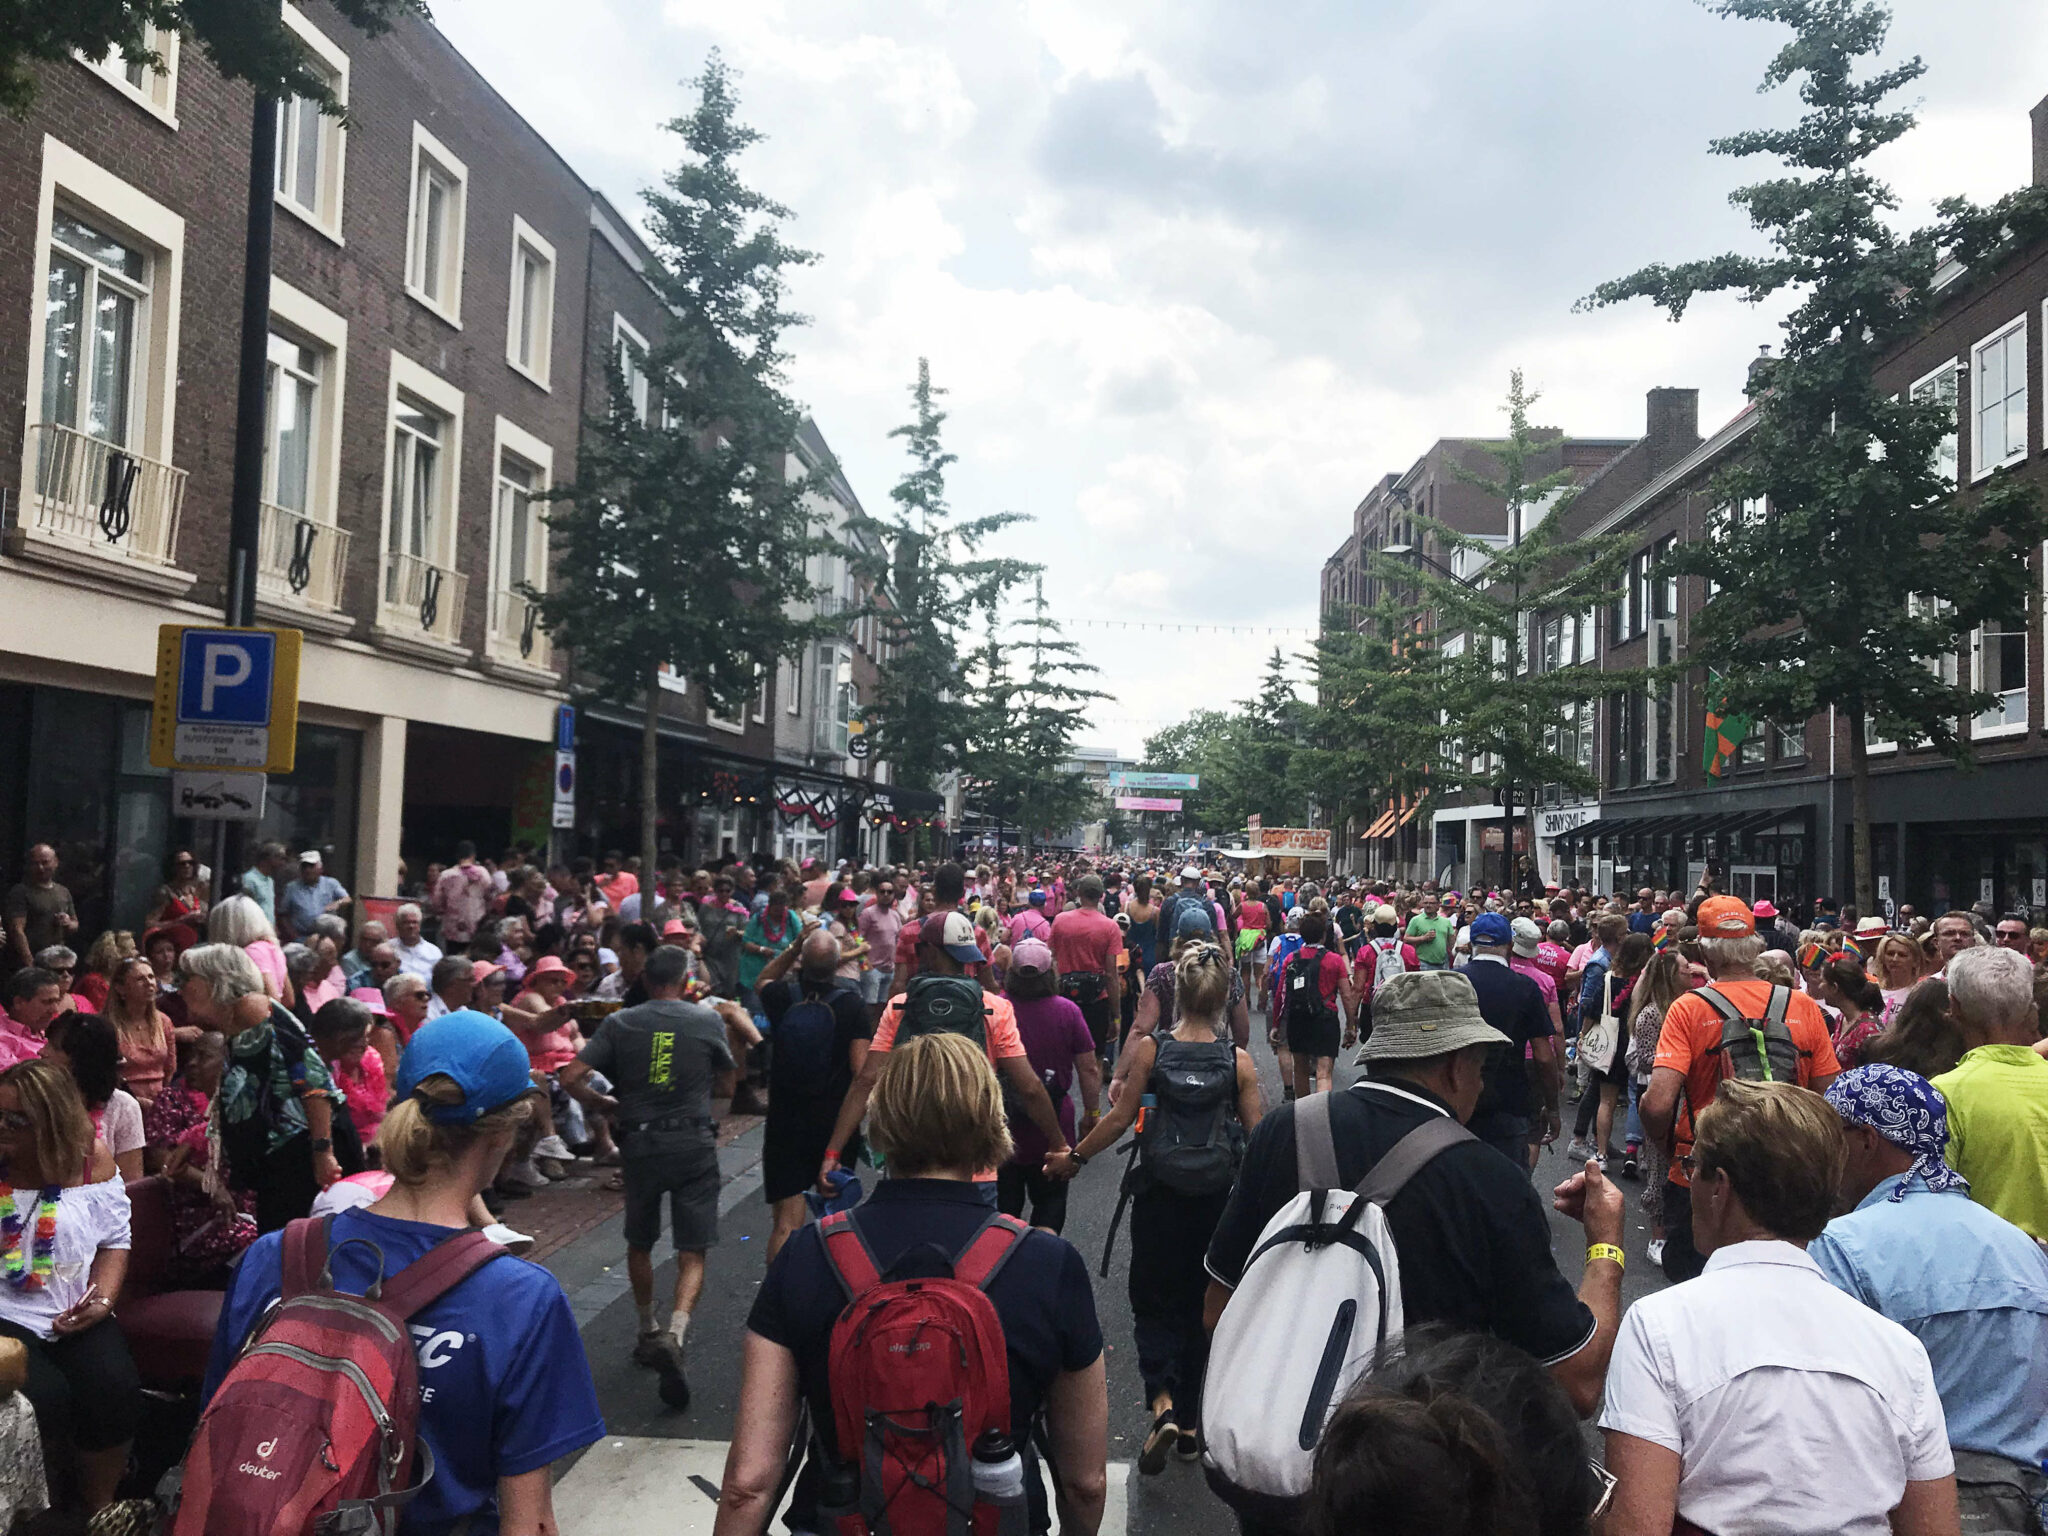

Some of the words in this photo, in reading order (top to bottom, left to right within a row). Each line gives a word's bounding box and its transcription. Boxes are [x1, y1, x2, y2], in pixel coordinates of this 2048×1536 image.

[201, 643, 253, 712] P
[1539, 948, 1558, 958] Walk
[239, 1461, 281, 1480] deuter
